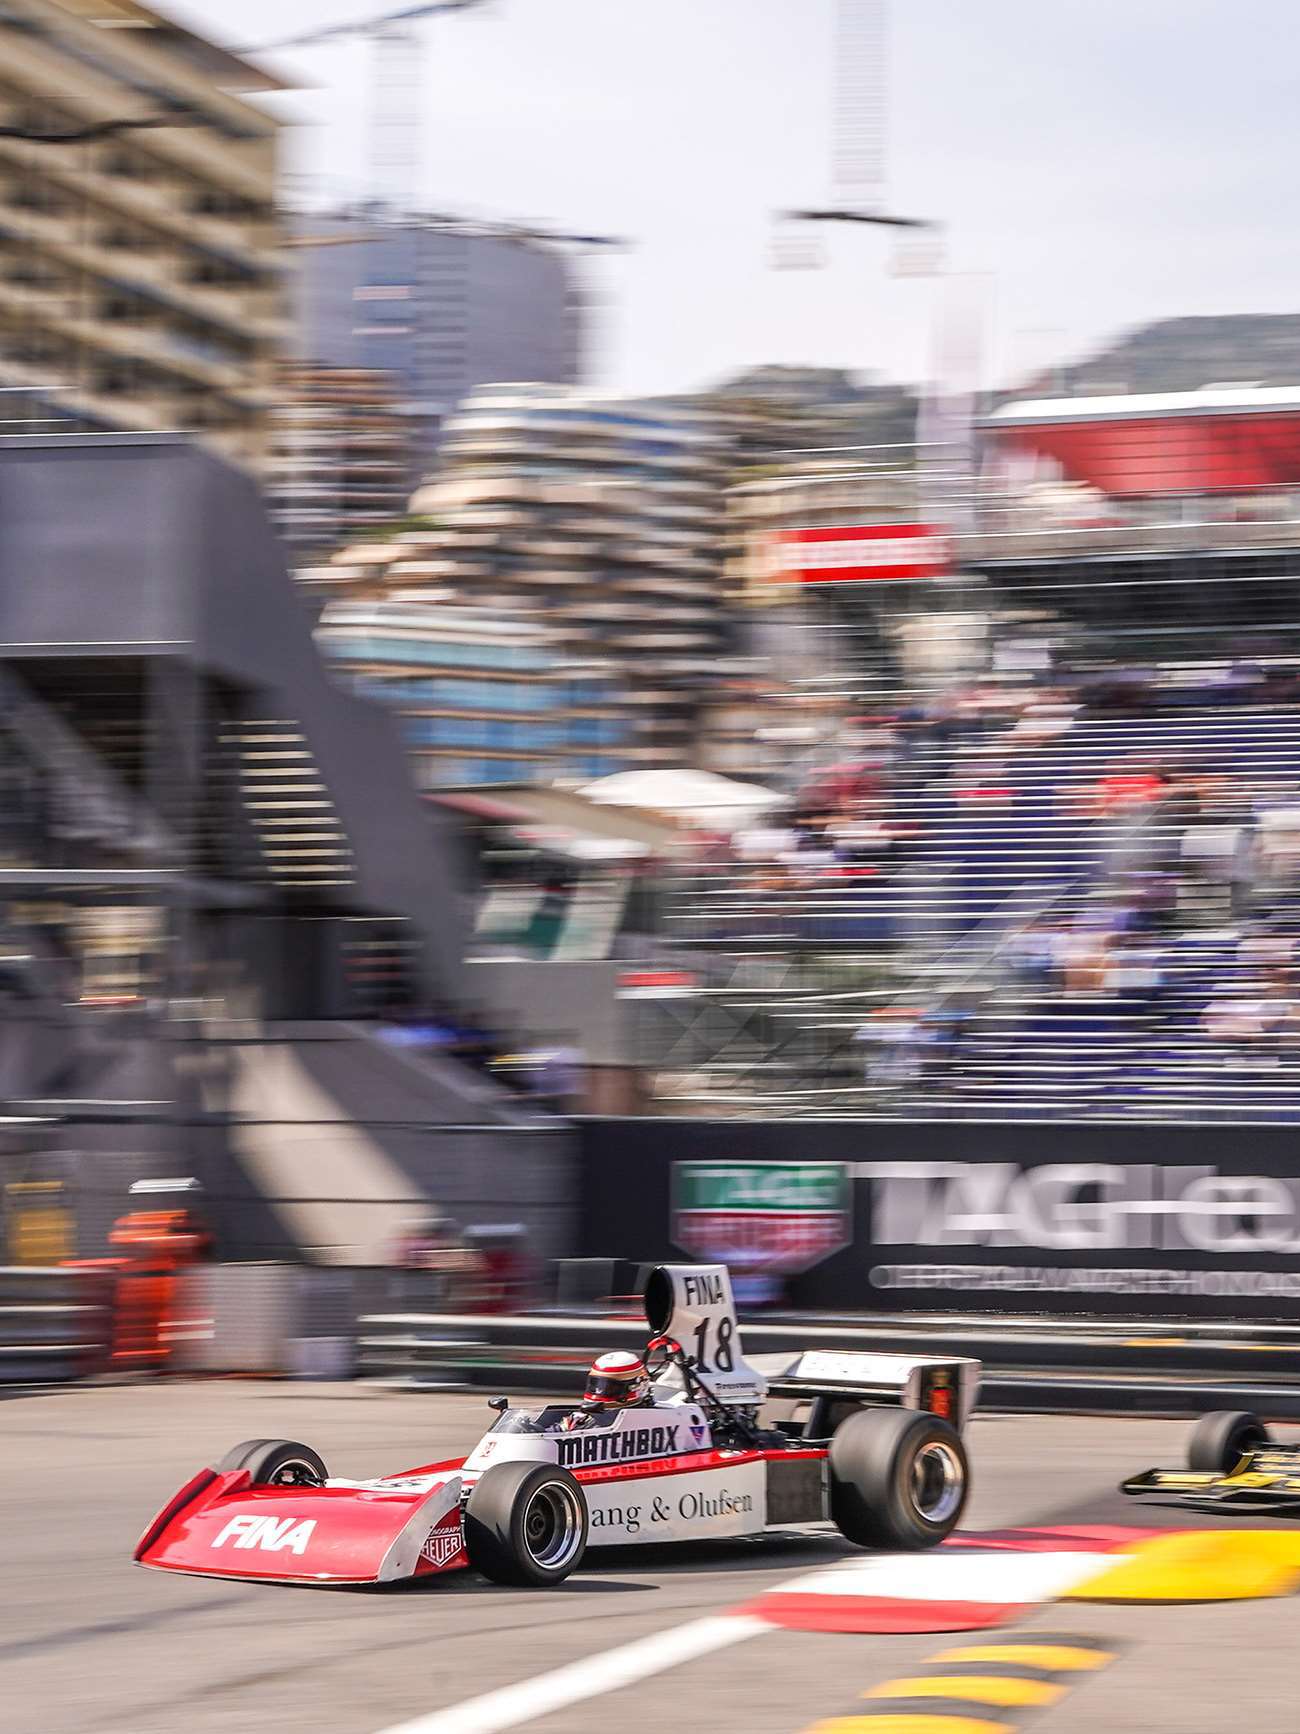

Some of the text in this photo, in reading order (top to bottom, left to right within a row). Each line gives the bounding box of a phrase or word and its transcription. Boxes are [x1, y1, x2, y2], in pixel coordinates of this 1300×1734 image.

[683, 1275, 726, 1306] FINA
[693, 1317, 734, 1374] 18
[554, 1425, 680, 1466] MATCHBOX
[591, 1489, 753, 1533] ang & Olufsen
[210, 1514, 318, 1556] FINA
[422, 1537, 459, 1563] HEUER
